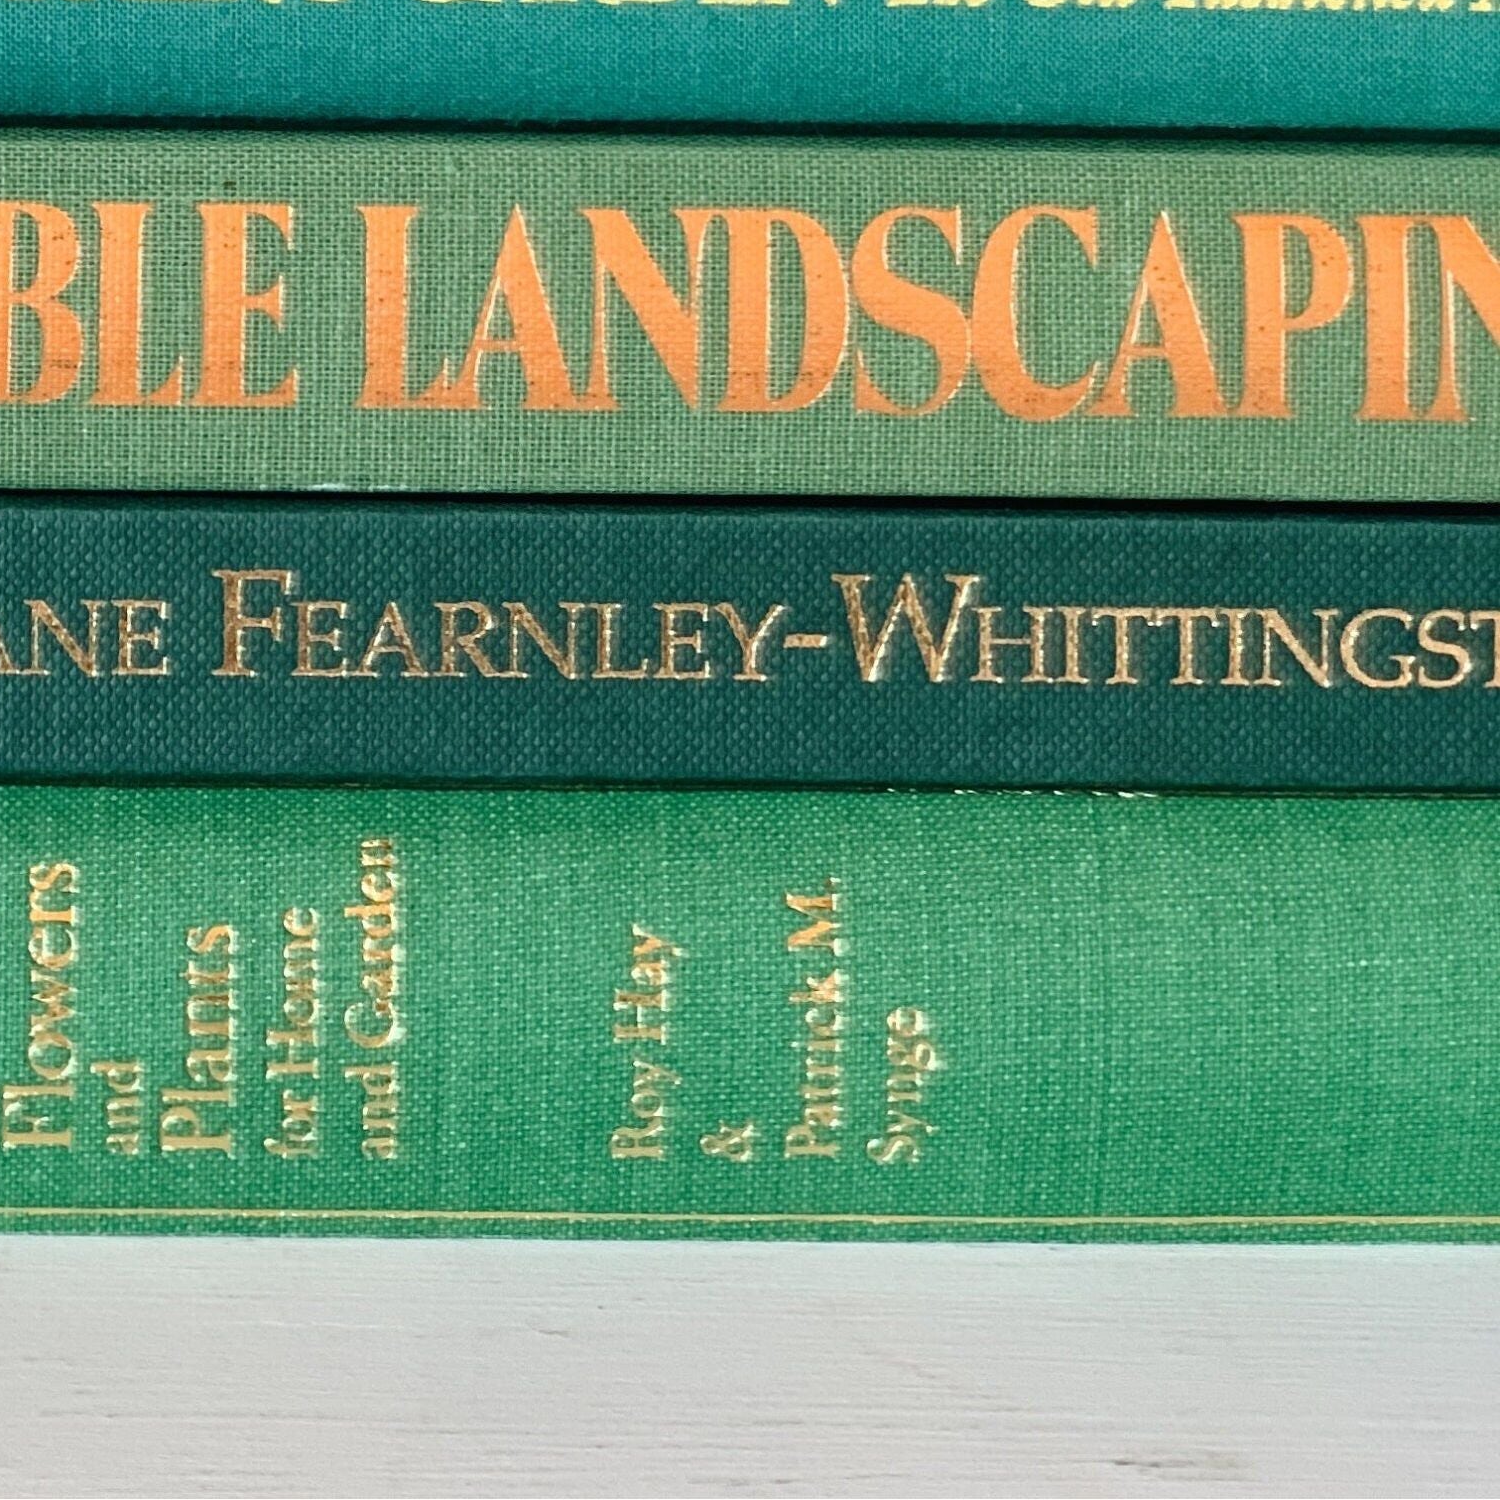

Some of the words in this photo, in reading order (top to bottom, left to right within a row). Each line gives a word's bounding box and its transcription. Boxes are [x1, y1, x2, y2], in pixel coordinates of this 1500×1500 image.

[344, 838, 402, 1049] Garden
[785, 877, 843, 957] M.
[3, 863, 79, 1150] Flowers
[159, 924, 236, 1159] Plants
[266, 905, 320, 1080] Home
[612, 923, 686, 1046] Hay
[91, 1060, 143, 1156] and
[264, 1088, 318, 1159] for
[344, 1062, 398, 1160] and
[609, 1059, 682, 1160] Roy
[784, 968, 843, 1160] Patrick
[866, 1006, 937, 1164] Synge
[699, 1120, 754, 1162] &
